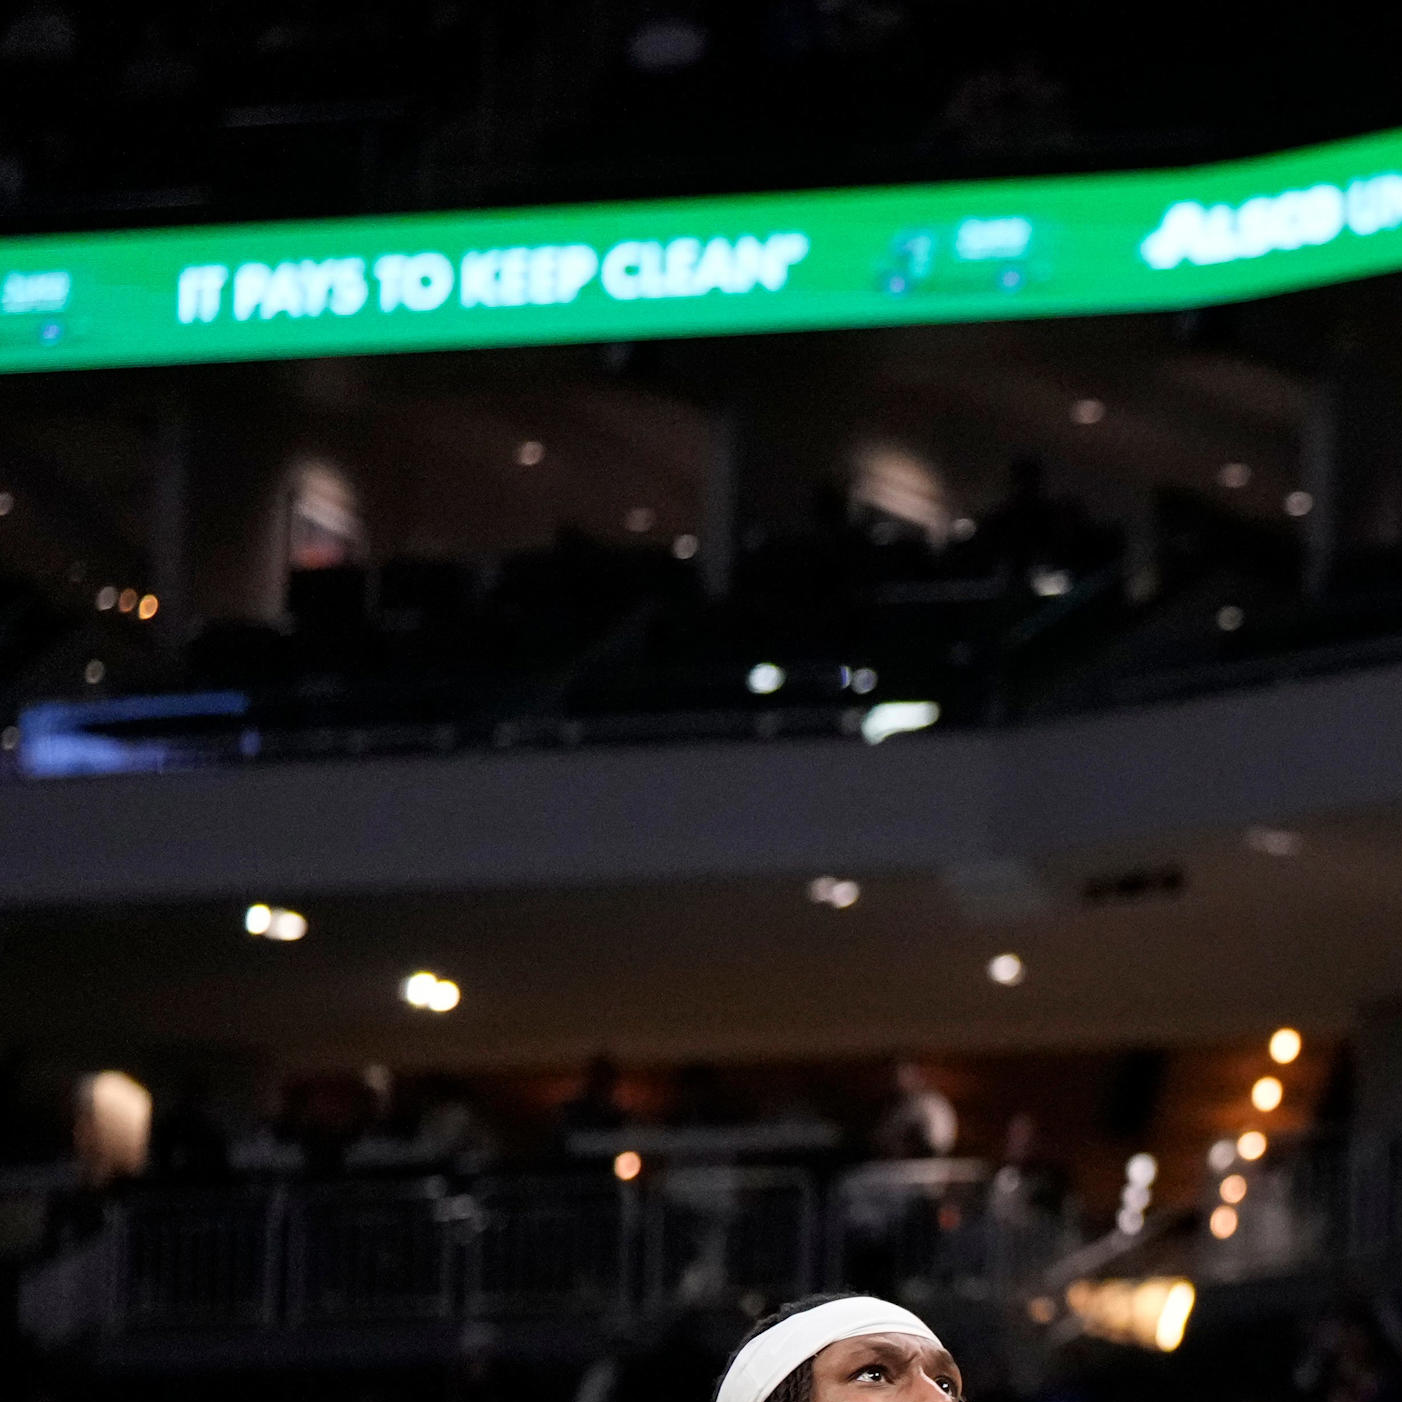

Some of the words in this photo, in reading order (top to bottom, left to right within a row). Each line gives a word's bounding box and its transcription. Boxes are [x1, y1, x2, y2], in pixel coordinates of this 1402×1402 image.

[178, 265, 227, 323] IT
[233, 258, 368, 321] PAYS
[375, 252, 453, 312] TO
[459, 244, 599, 307] KEEP
